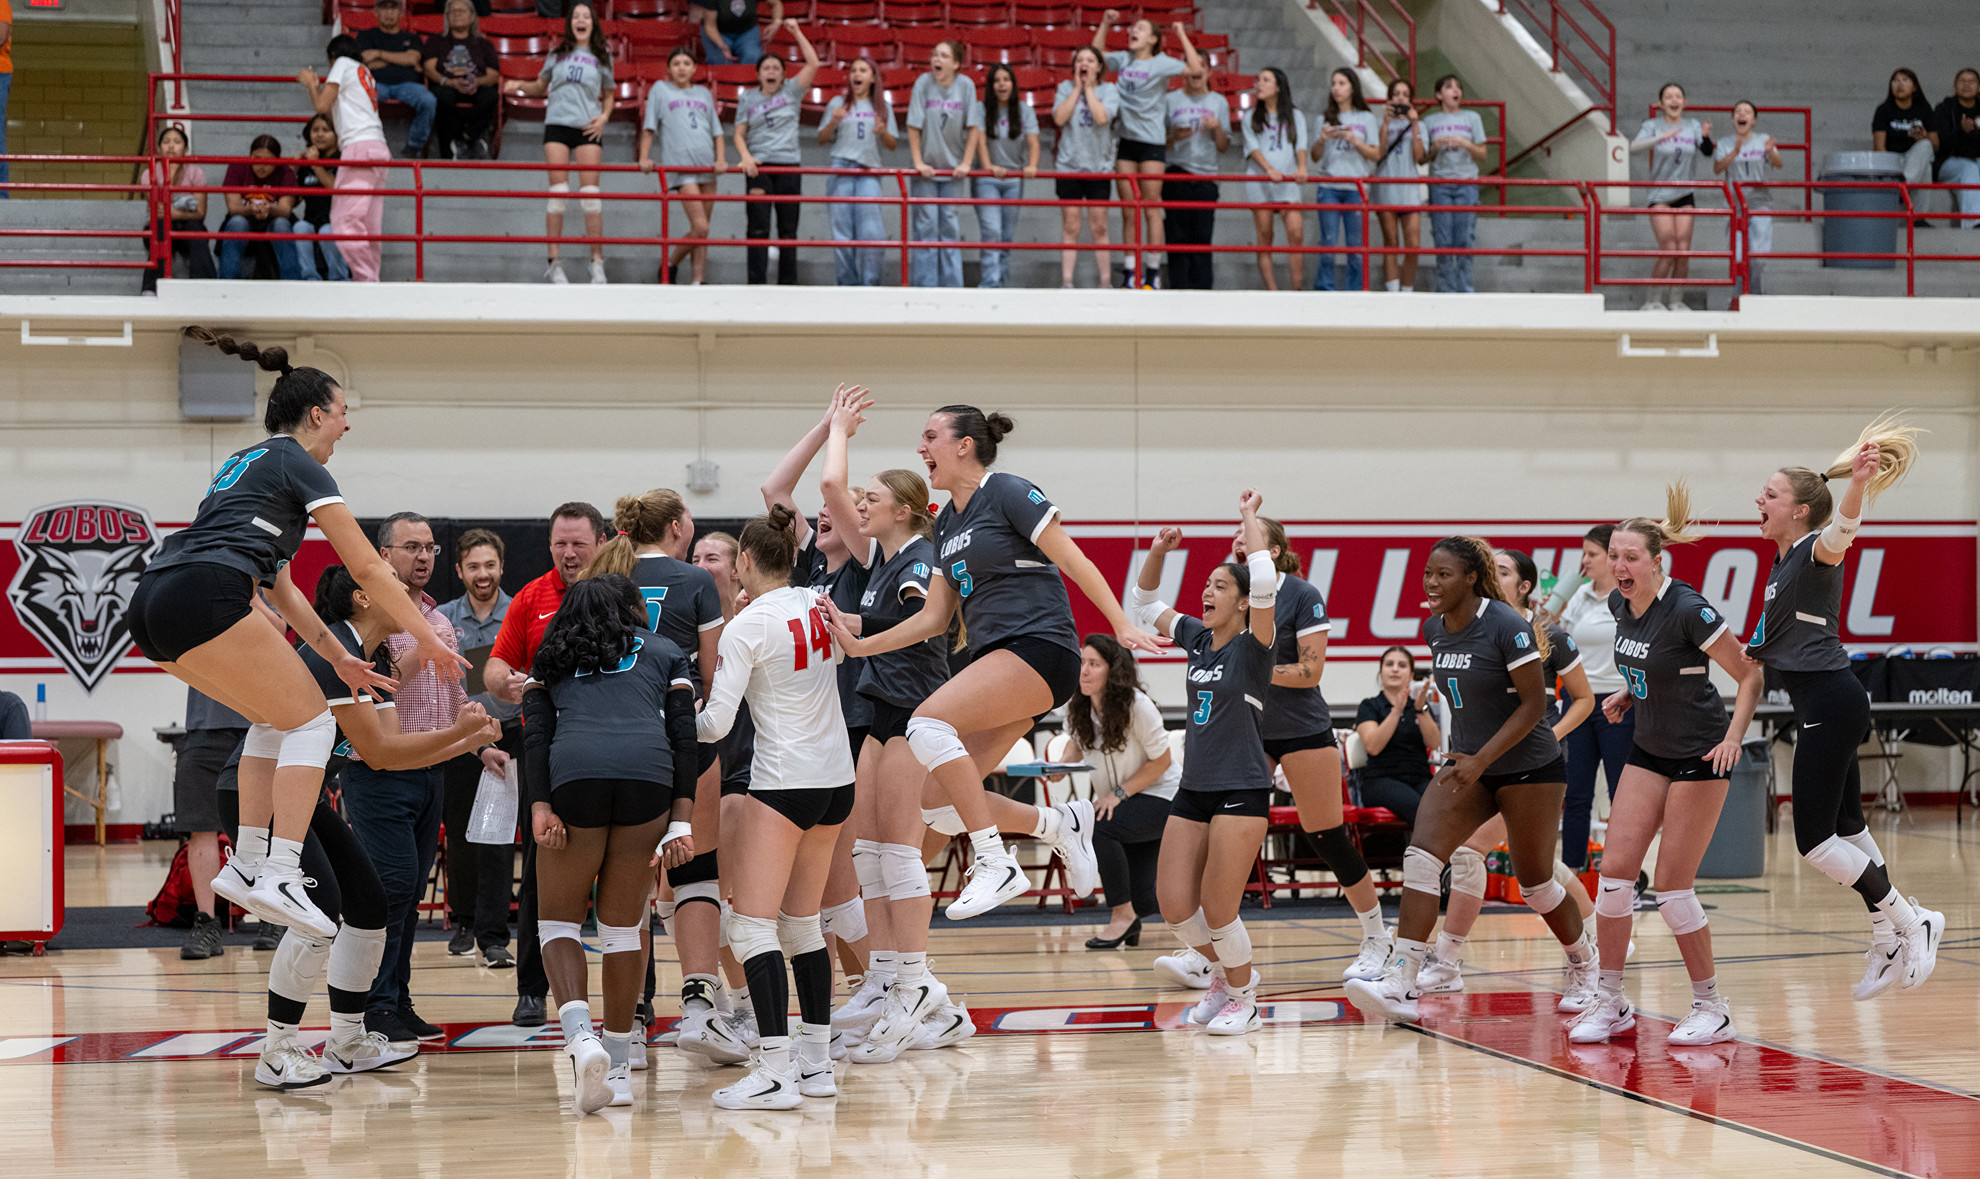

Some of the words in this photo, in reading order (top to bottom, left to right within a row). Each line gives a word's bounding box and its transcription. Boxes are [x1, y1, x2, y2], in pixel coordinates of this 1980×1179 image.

[567, 65, 584, 83] 30
[857, 121, 866, 140] 6
[1611, 145, 1624, 164] C
[23, 504, 152, 544] LOBOS
[940, 528, 974, 560] LOBOS
[951, 559, 974, 598] 5
[787, 605, 833, 672] 14
[1615, 635, 1651, 660] LOBOS
[1435, 652, 1473, 670] LOBOS
[1447, 677, 1464, 709] 1
[1618, 664, 1649, 700] 13
[1908, 687, 1974, 705] molten
[1193, 690, 1214, 725] 3
